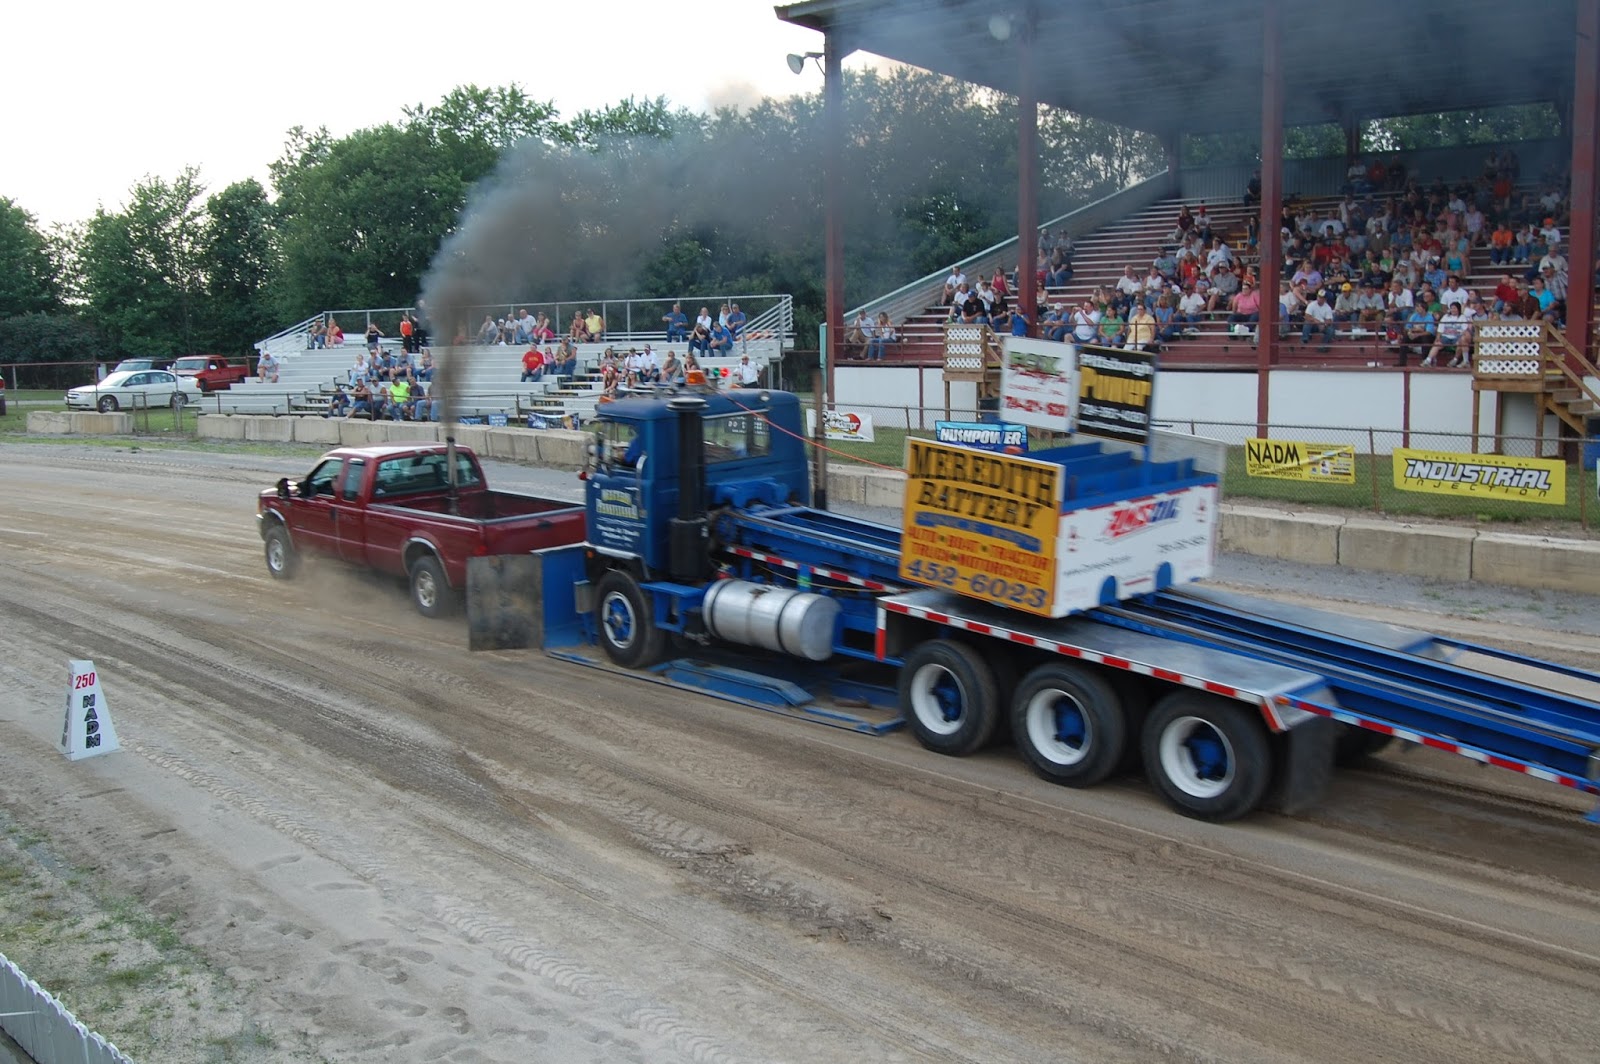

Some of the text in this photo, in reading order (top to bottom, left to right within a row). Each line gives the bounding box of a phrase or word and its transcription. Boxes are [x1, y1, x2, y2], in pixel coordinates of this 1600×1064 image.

[941, 427, 1022, 445] HUSHPOWER
[1247, 441, 1301, 466] NADM
[910, 444, 1056, 509] MEREDITH
[916, 480, 1043, 529] BATTERY
[905, 559, 1047, 608] 452-6023
[75, 672, 96, 690] 250
[82, 693, 101, 749] NADM
